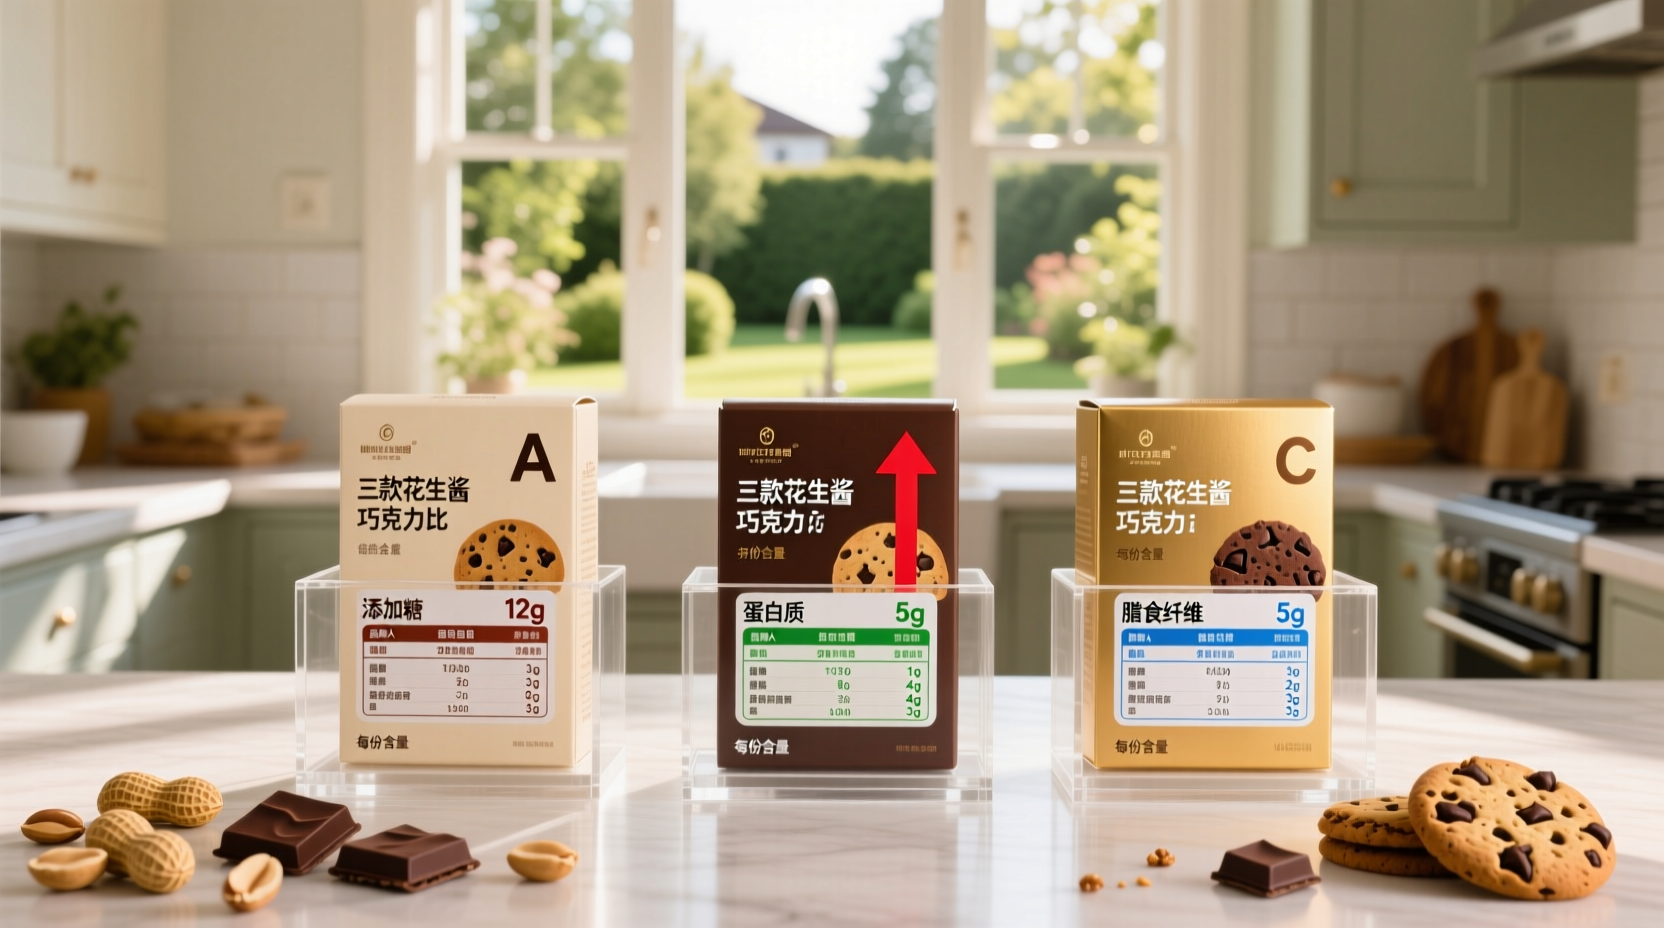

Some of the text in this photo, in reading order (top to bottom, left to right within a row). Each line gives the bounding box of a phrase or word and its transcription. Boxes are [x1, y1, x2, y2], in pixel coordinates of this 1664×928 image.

[510, 433, 556, 482] A
[1276, 437, 1316, 485] C
[357, 475, 470, 502] 三款花生酱
[737, 478, 854, 506] 三款花生酱
[1116, 479, 1232, 506] 三款花生酱
[357, 505, 448, 531] 巧克力比
[362, 597, 423, 621] 添加糖
[505, 598, 545, 625] 12g
[744, 601, 804, 623] 蛋白质
[895, 602, 925, 627] 5g
[1276, 602, 1305, 628] 5g
